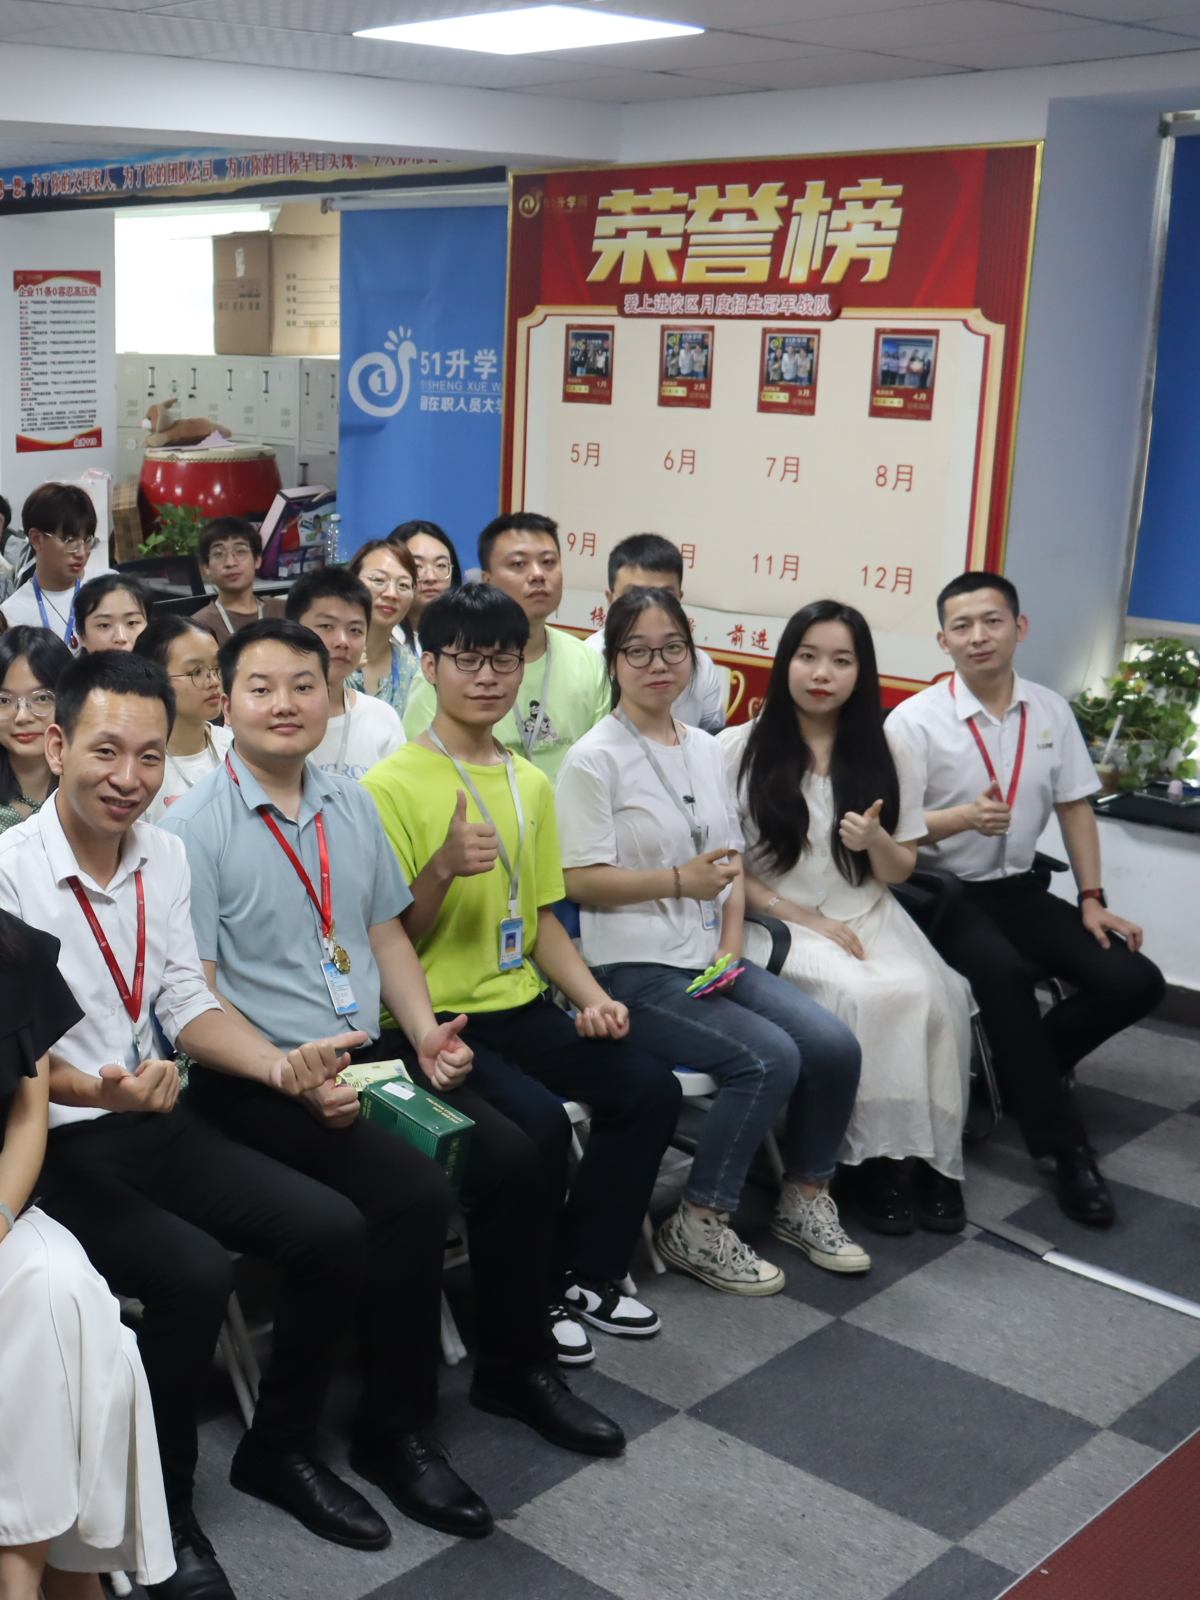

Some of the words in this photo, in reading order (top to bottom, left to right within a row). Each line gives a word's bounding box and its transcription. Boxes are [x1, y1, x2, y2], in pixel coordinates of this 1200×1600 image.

[585, 177, 904, 284] 荣誉榜
[624, 293, 832, 316] 爱上进校区月度招生冠军战队
[420, 349, 498, 380] 51升学
[570, 442, 601, 468] 5月
[663, 448, 697, 475] 6月
[765, 456, 801, 484] 7月
[875, 464, 915, 493] 8月
[566, 532, 597, 558] 9月
[751, 553, 800, 582] 11月
[860, 566, 914, 596] 12月
[726, 623, 770, 651] 前进
